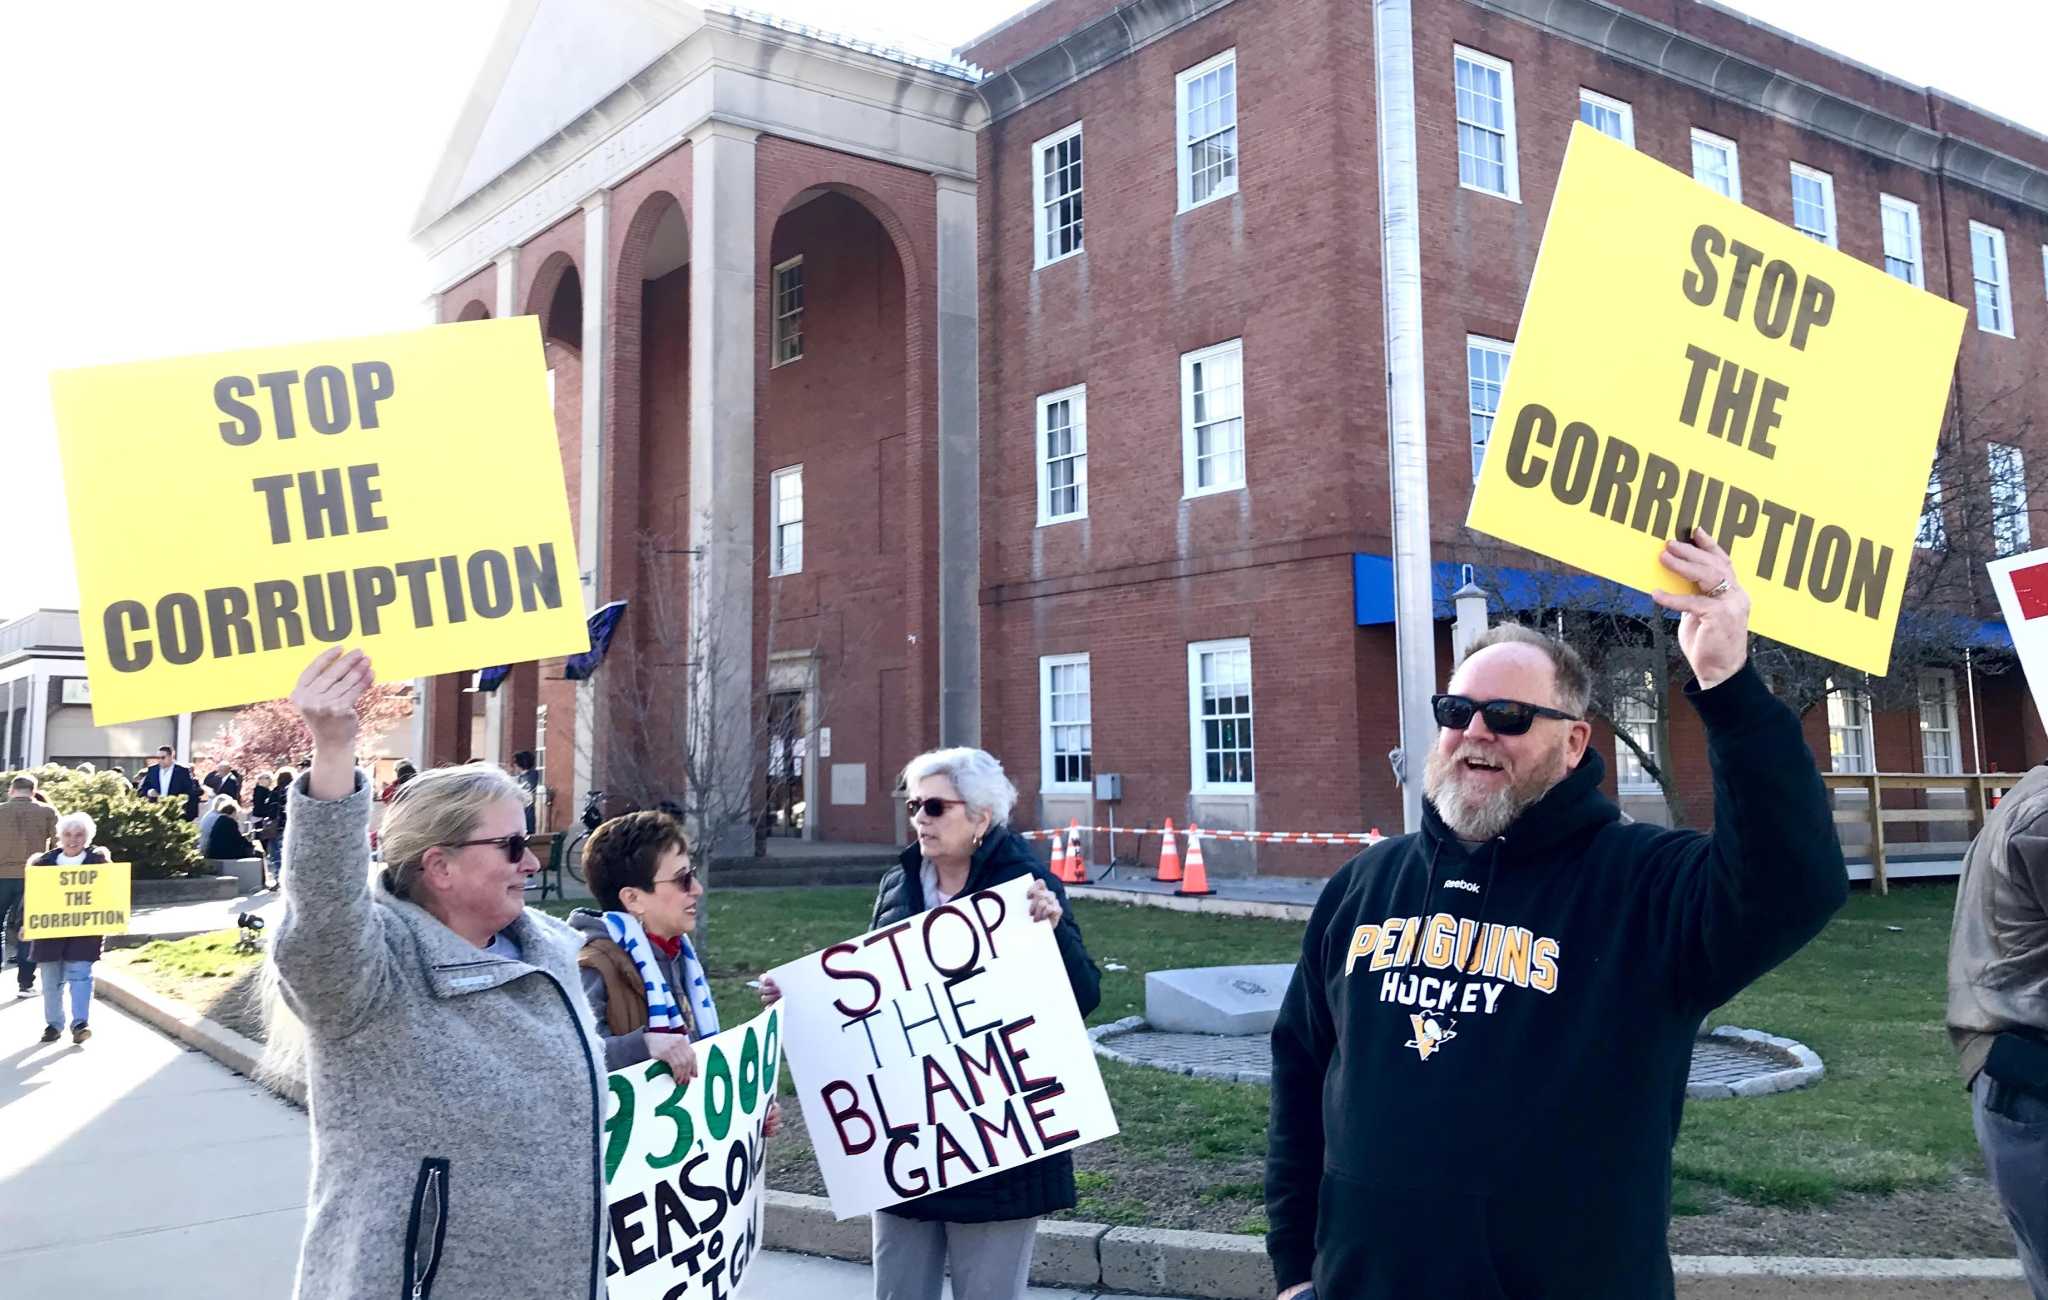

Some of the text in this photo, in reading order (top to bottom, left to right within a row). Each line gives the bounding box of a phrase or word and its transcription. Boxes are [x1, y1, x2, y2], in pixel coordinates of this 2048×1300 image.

[1683, 224, 1836, 352] STOP
[213, 360, 395, 447] STOP
[1679, 343, 1790, 460] THE
[252, 462, 389, 545] THE
[1505, 403, 1894, 621] CORRUPTION
[103, 542, 563, 673] CORRUPTION
[29, 910, 125, 930] CORRUPTION
[60, 870, 98, 886] STOP
[65, 891, 92, 906] THE
[1443, 879, 1481, 894] Reebok
[820, 889, 1006, 1018] STOP
[1345, 913, 1560, 994] PENGUINS
[1379, 971, 1505, 1014] HOCKEY
[841, 966, 1003, 1069] THE
[820, 1014, 1058, 1156] BLAME
[883, 1082, 1081, 1199] GAME
[671, 1230, 725, 1277] TO
